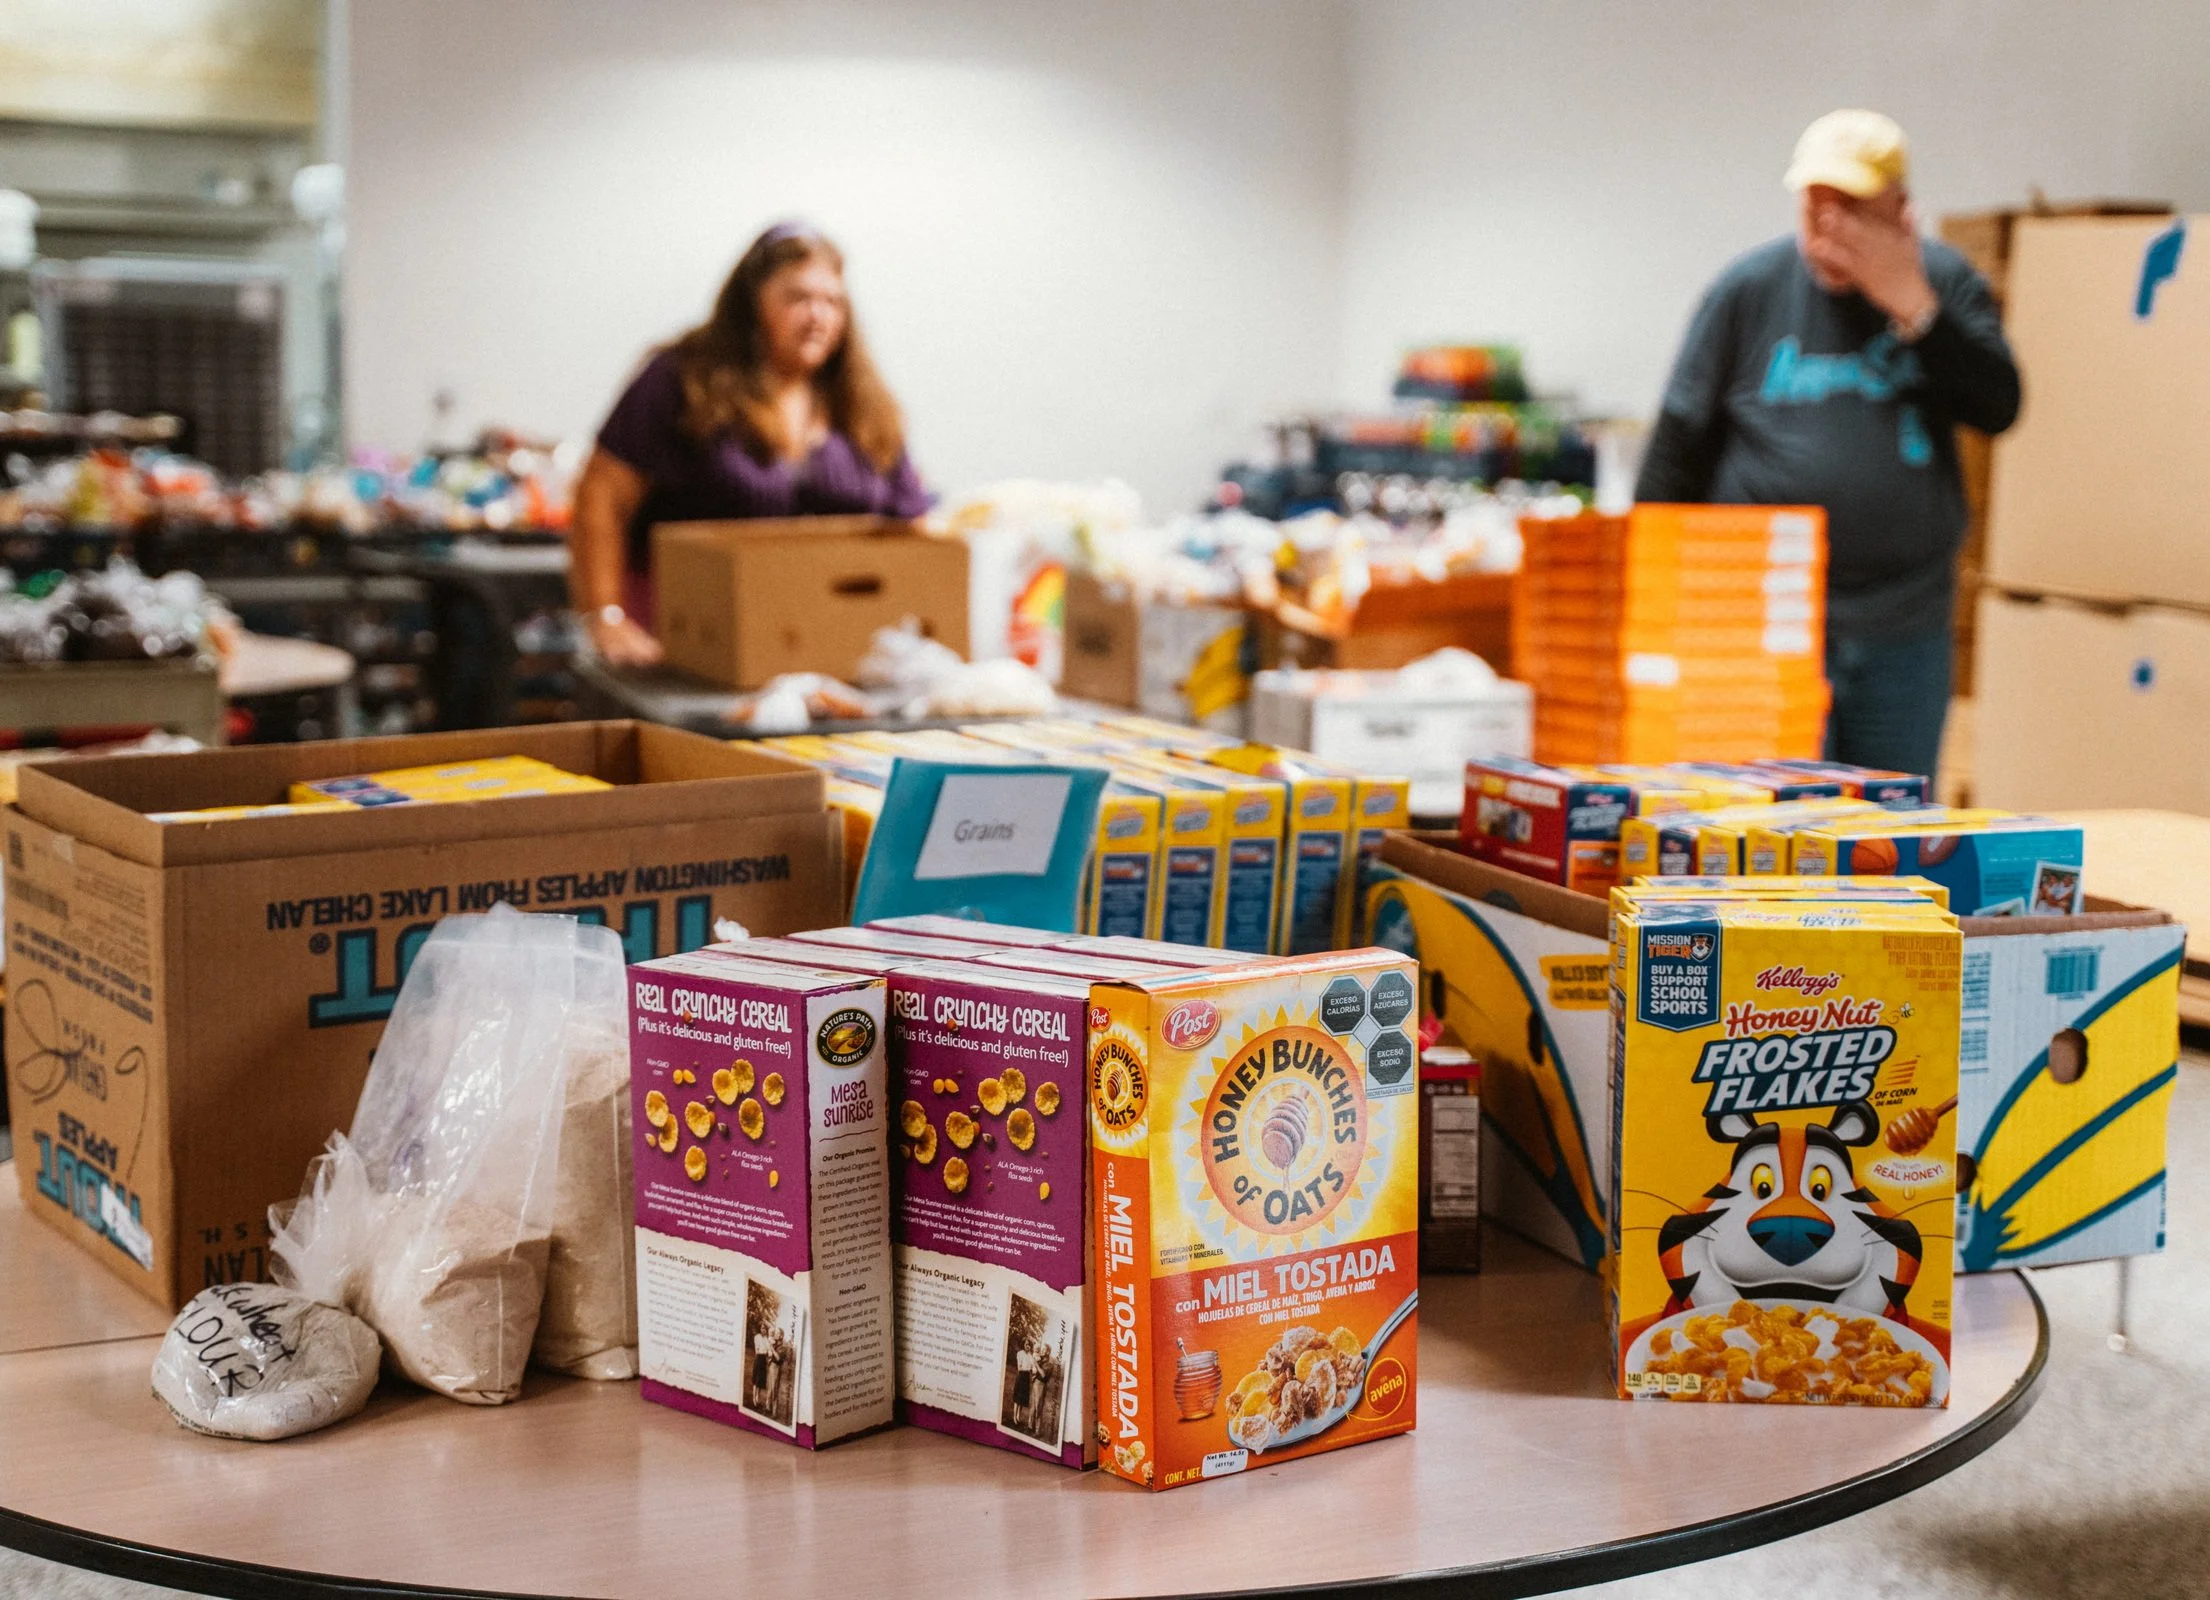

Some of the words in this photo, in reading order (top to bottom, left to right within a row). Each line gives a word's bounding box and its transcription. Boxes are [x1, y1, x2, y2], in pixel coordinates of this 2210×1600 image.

[954, 819, 1015, 844] Grains
[536, 869, 625, 902] APPLES
[635, 855, 790, 893] WASHINGTON
[382, 885, 447, 920] LAKE
[459, 878, 530, 909] FROM
[266, 891, 372, 931] CHELAN
[1647, 934, 1691, 945] MISSION
[1647, 944, 1692, 960] TIGER
[1651, 965, 1674, 975] BUY
[1676, 965, 1684, 975] A
[1687, 965, 1708, 975] BOX
[1651, 975, 1709, 986] SUPPORT
[1756, 966, 1841, 996] Kellogg's
[1330, 996, 1358, 1006] EXCESO
[1378, 990, 1405, 1000] EXCESO
[1650, 986, 1708, 1000] SCHOOL
[1090, 1008, 1108, 1026] Post
[1326, 1004, 1361, 1016] CALORÍAS
[1650, 1000, 1708, 1015] SPORTS
[1728, 1003, 1821, 1037] Honey
[1826, 999, 1881, 1029] Nut
[820, 1012, 854, 1038] NATURE'S
[855, 1012, 873, 1031] PATH
[1170, 1005, 1211, 1041] Post
[637, 1015, 657, 1033] (Plus
[658, 1020, 671, 1035] it's
[672, 1021, 712, 1041] delicious
[713, 1032, 732, 1046] and
[733, 1032, 764, 1051] gluten
[765, 1037, 791, 1059] free!)
[894, 1024, 917, 1041] (Plus
[918, 1030, 933, 1043] it's
[934, 1031, 979, 1051] delicious
[981, 1040, 1001, 1055] and
[1003, 1041, 1037, 1060] gluten
[1039, 1046, 1069, 1068] free!)
[832, 1050, 864, 1063] ORGANIC
[1376, 1048, 1404, 1058] EXCESO
[1379, 1058, 1401, 1067] SODIO
[1699, 1030, 1894, 1081] FROSTED
[1093, 1045, 1110, 1090] HONEY
[1110, 1043, 1144, 1100] BUNCHES
[1212, 1047, 1267, 1165] HONEY
[1271, 1038, 1358, 1145] BUNCHES
[1710, 1066, 1877, 1113] FLAKES
[1874, 1090, 1889, 1100] OF
[1890, 1087, 1918, 1098] CORN
[1106, 1104, 1137, 1126] OATS
[57, 1111, 118, 1171] APPLES
[834, 1151, 855, 1161] Organic
[855, 1146, 876, 1155] Promise
[997, 1161, 1009, 1170] ALA
[1009, 1162, 1033, 1174] Omega-3
[1032, 1166, 1044, 1175] rich
[1007, 1171, 1018, 1180] flax
[1018, 1174, 1033, 1183] seeds
[1107, 1162, 1115, 1189] con
[1873, 1163, 1901, 1181] REAL
[1903, 1164, 1944, 1181] HONEY!
[1263, 1162, 1344, 1225] OATS
[963, 1206, 983, 1217] delicate
[983, 1210, 998, 1220] blend
[998, 1213, 1005, 1222] of
[1004, 1215, 1023, 1227] organic
[974, 1218, 989, 1230] super
[988, 1221, 1008, 1234] crunchy
[1008, 1225, 1018, 1235] and
[1017, 1228, 1041, 1240] delicious
[1040, 1233, 1065, 1245] breakfast
[1108, 1194, 1134, 1272] MIEL
[964, 1237, 978, 1248] good
[977, 1240, 993, 1251] gluten
[993, 1243, 1004, 1253] free
[1003, 1246, 1014, 1255] can
[1000, 1235, 1029, 1248] wholesome
[1029, 1241, 1057, 1254] ingredients
[1193, 1242, 1205, 1251] CON
[1193, 1247, 1224, 1259] MINERALES
[646, 1246, 658, 1256] Our
[679, 1255, 703, 1269] Organic
[703, 1261, 724, 1275] Legacy
[910, 1263, 933, 1278] Always
[933, 1269, 960, 1283] Organic
[961, 1275, 985, 1289] Legacy
[1175, 1299, 1200, 1313] con
[1203, 1270, 1268, 1308] MIEL
[1274, 1244, 1396, 1294] TOSTADA
[838, 1283, 867, 1296] Non-GMO
[1198, 1305, 1234, 1323] HOJUELAS
[1235, 1303, 1244, 1316] DE
[1245, 1298, 1270, 1314] CEREAL
[1270, 1296, 1280, 1309] DE
[1302, 1288, 1323, 1304] TRIGO,
[1325, 1284, 1347, 1298] AVENA
[1347, 1283, 1352, 1294] Y
[1353, 1278, 1376, 1293] ARROZ
[1259, 1311, 1273, 1325] CON
[1273, 1308, 1290, 1322] MIEL
[1290, 1303, 1320, 1318] TOSTADA
[174, 1300, 265, 1398] LOUR
[1112, 1283, 1139, 1439] TOSTADA
[1369, 1376, 1403, 1403] avena
[1165, 1470, 1185, 1485] CONT.
[1186, 1466, 1202, 1480] NET.
